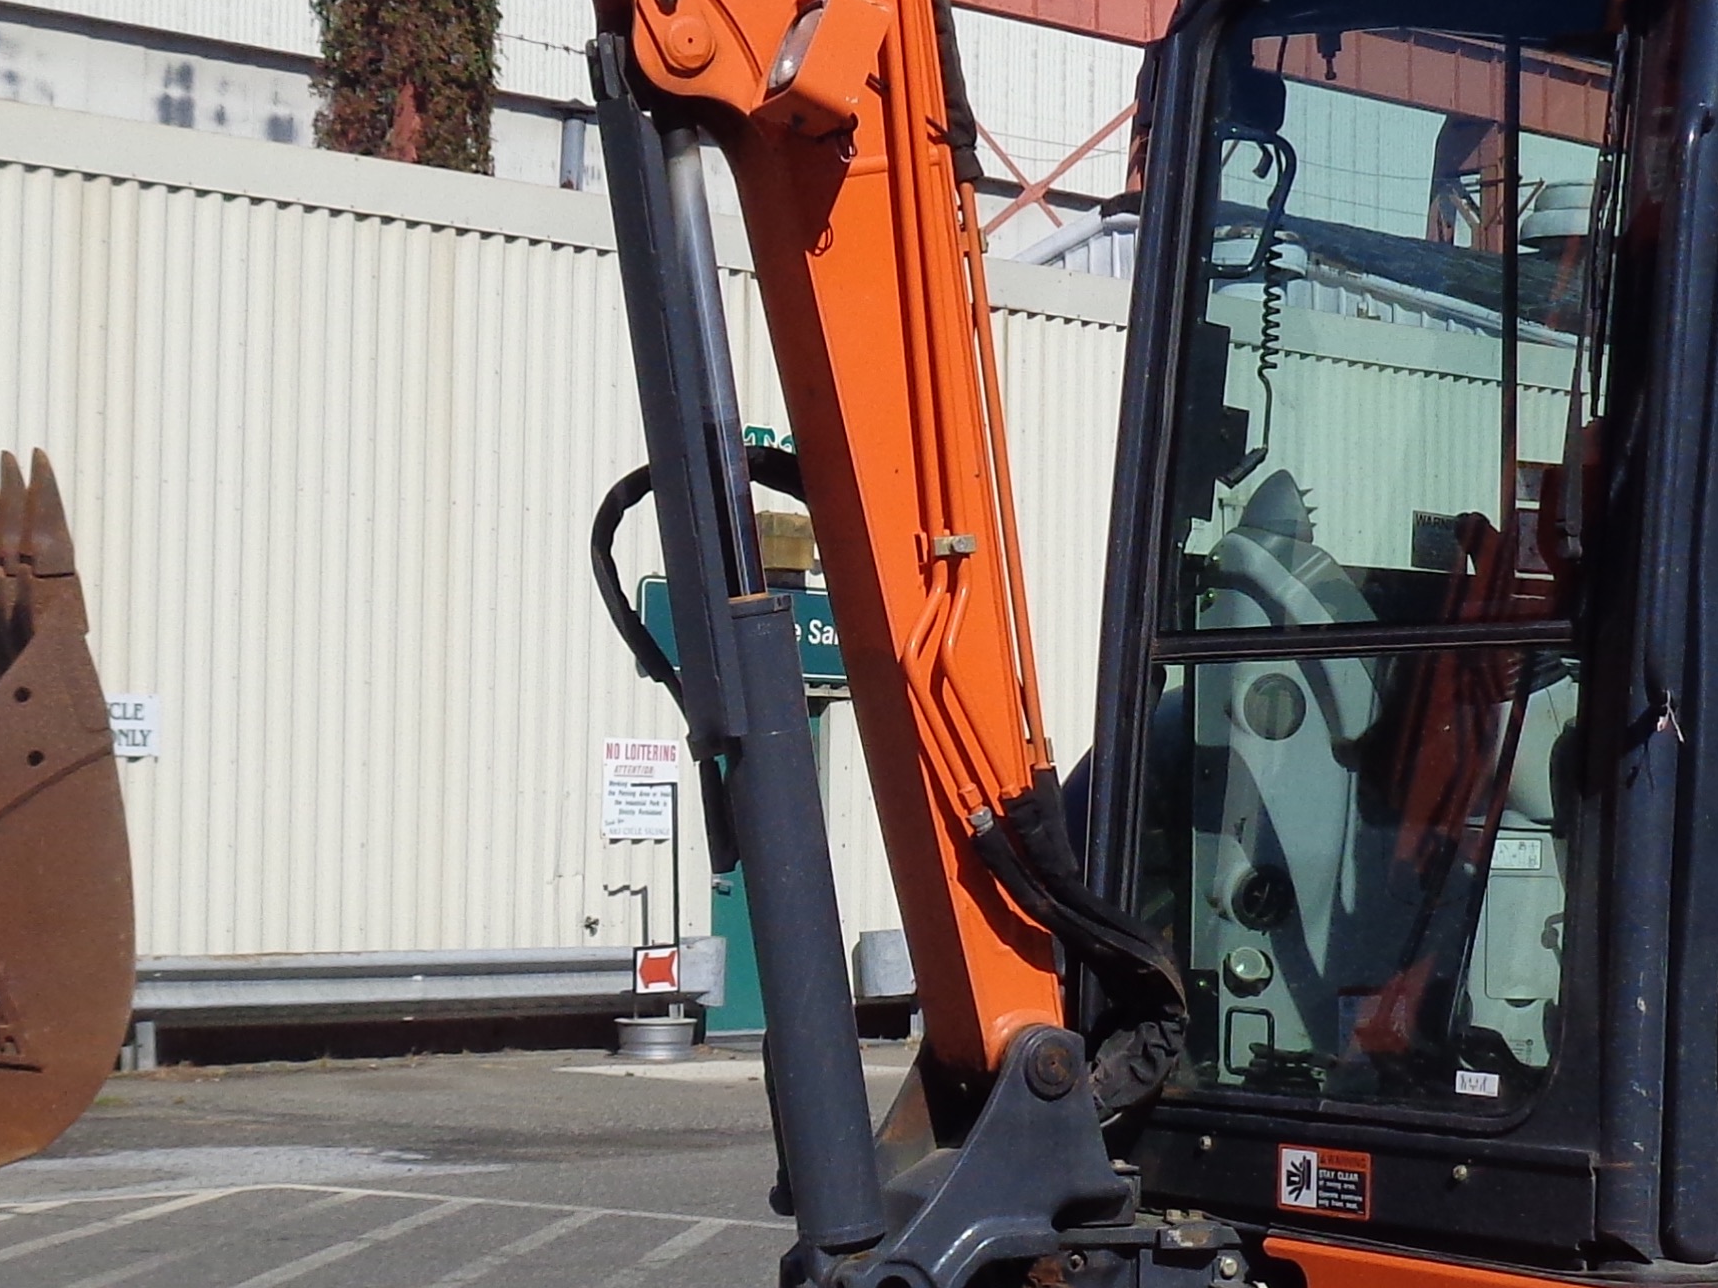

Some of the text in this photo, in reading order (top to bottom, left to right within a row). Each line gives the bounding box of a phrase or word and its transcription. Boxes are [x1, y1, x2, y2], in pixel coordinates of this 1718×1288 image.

[107, 702, 145, 721] CLE
[606, 743, 677, 762] NO LOITERING
[614, 765, 655, 775] ATTENTION
[1318, 1169, 1359, 1181] STAY CLEAR
